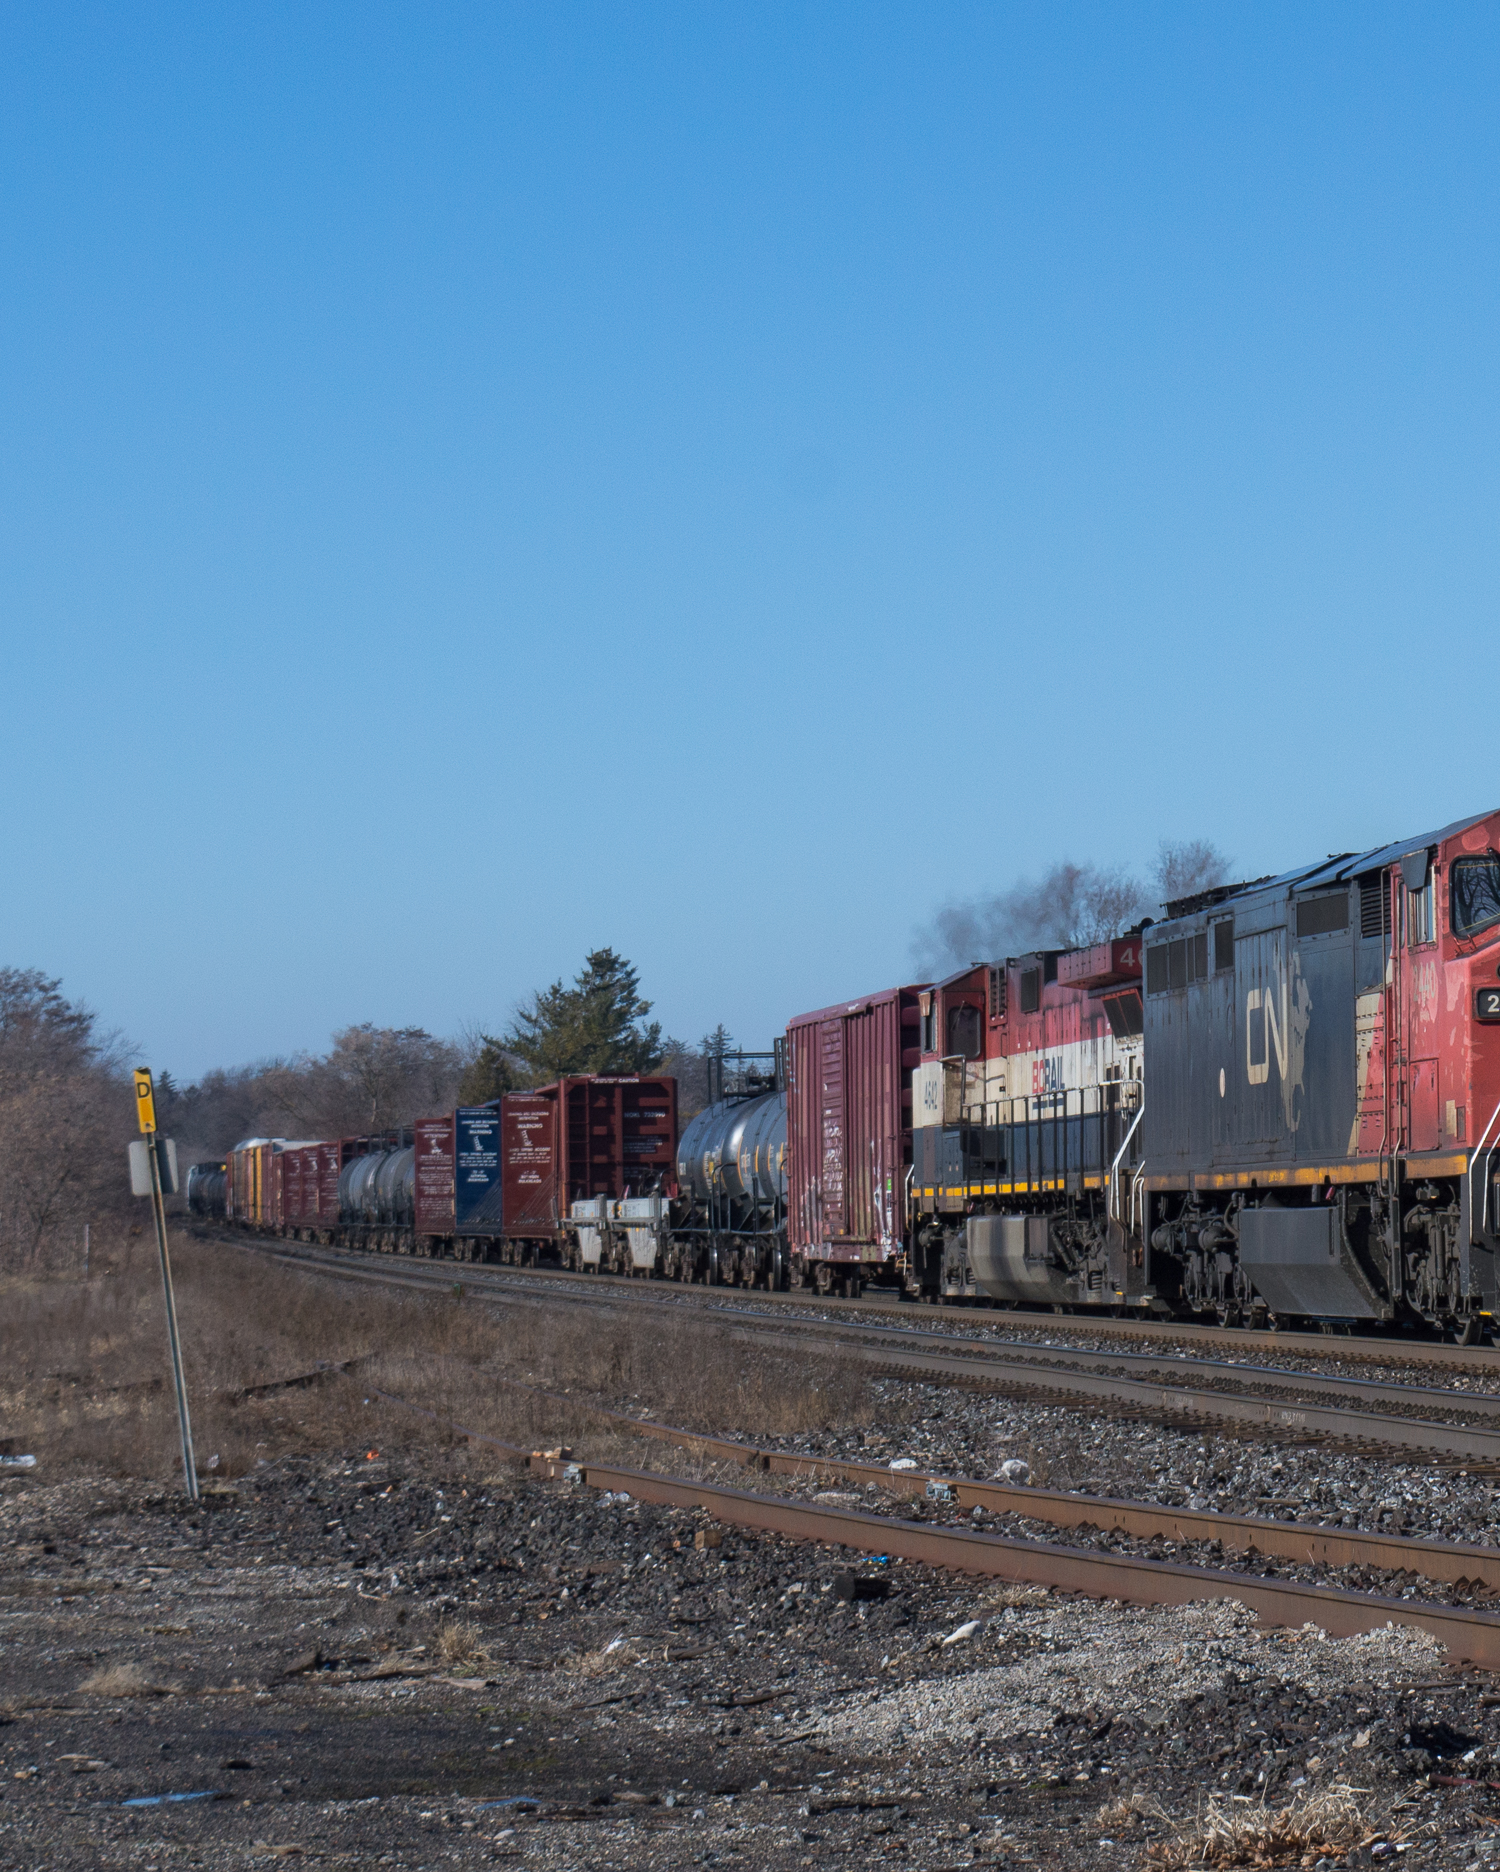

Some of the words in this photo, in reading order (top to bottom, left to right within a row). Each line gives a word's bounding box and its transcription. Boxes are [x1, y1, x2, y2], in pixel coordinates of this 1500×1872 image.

[1413, 961, 1436, 1002] 2440
[1246, 983, 1288, 1086] CN
[137, 1082, 150, 1098] D
[924, 1081, 938, 1110] 4642
